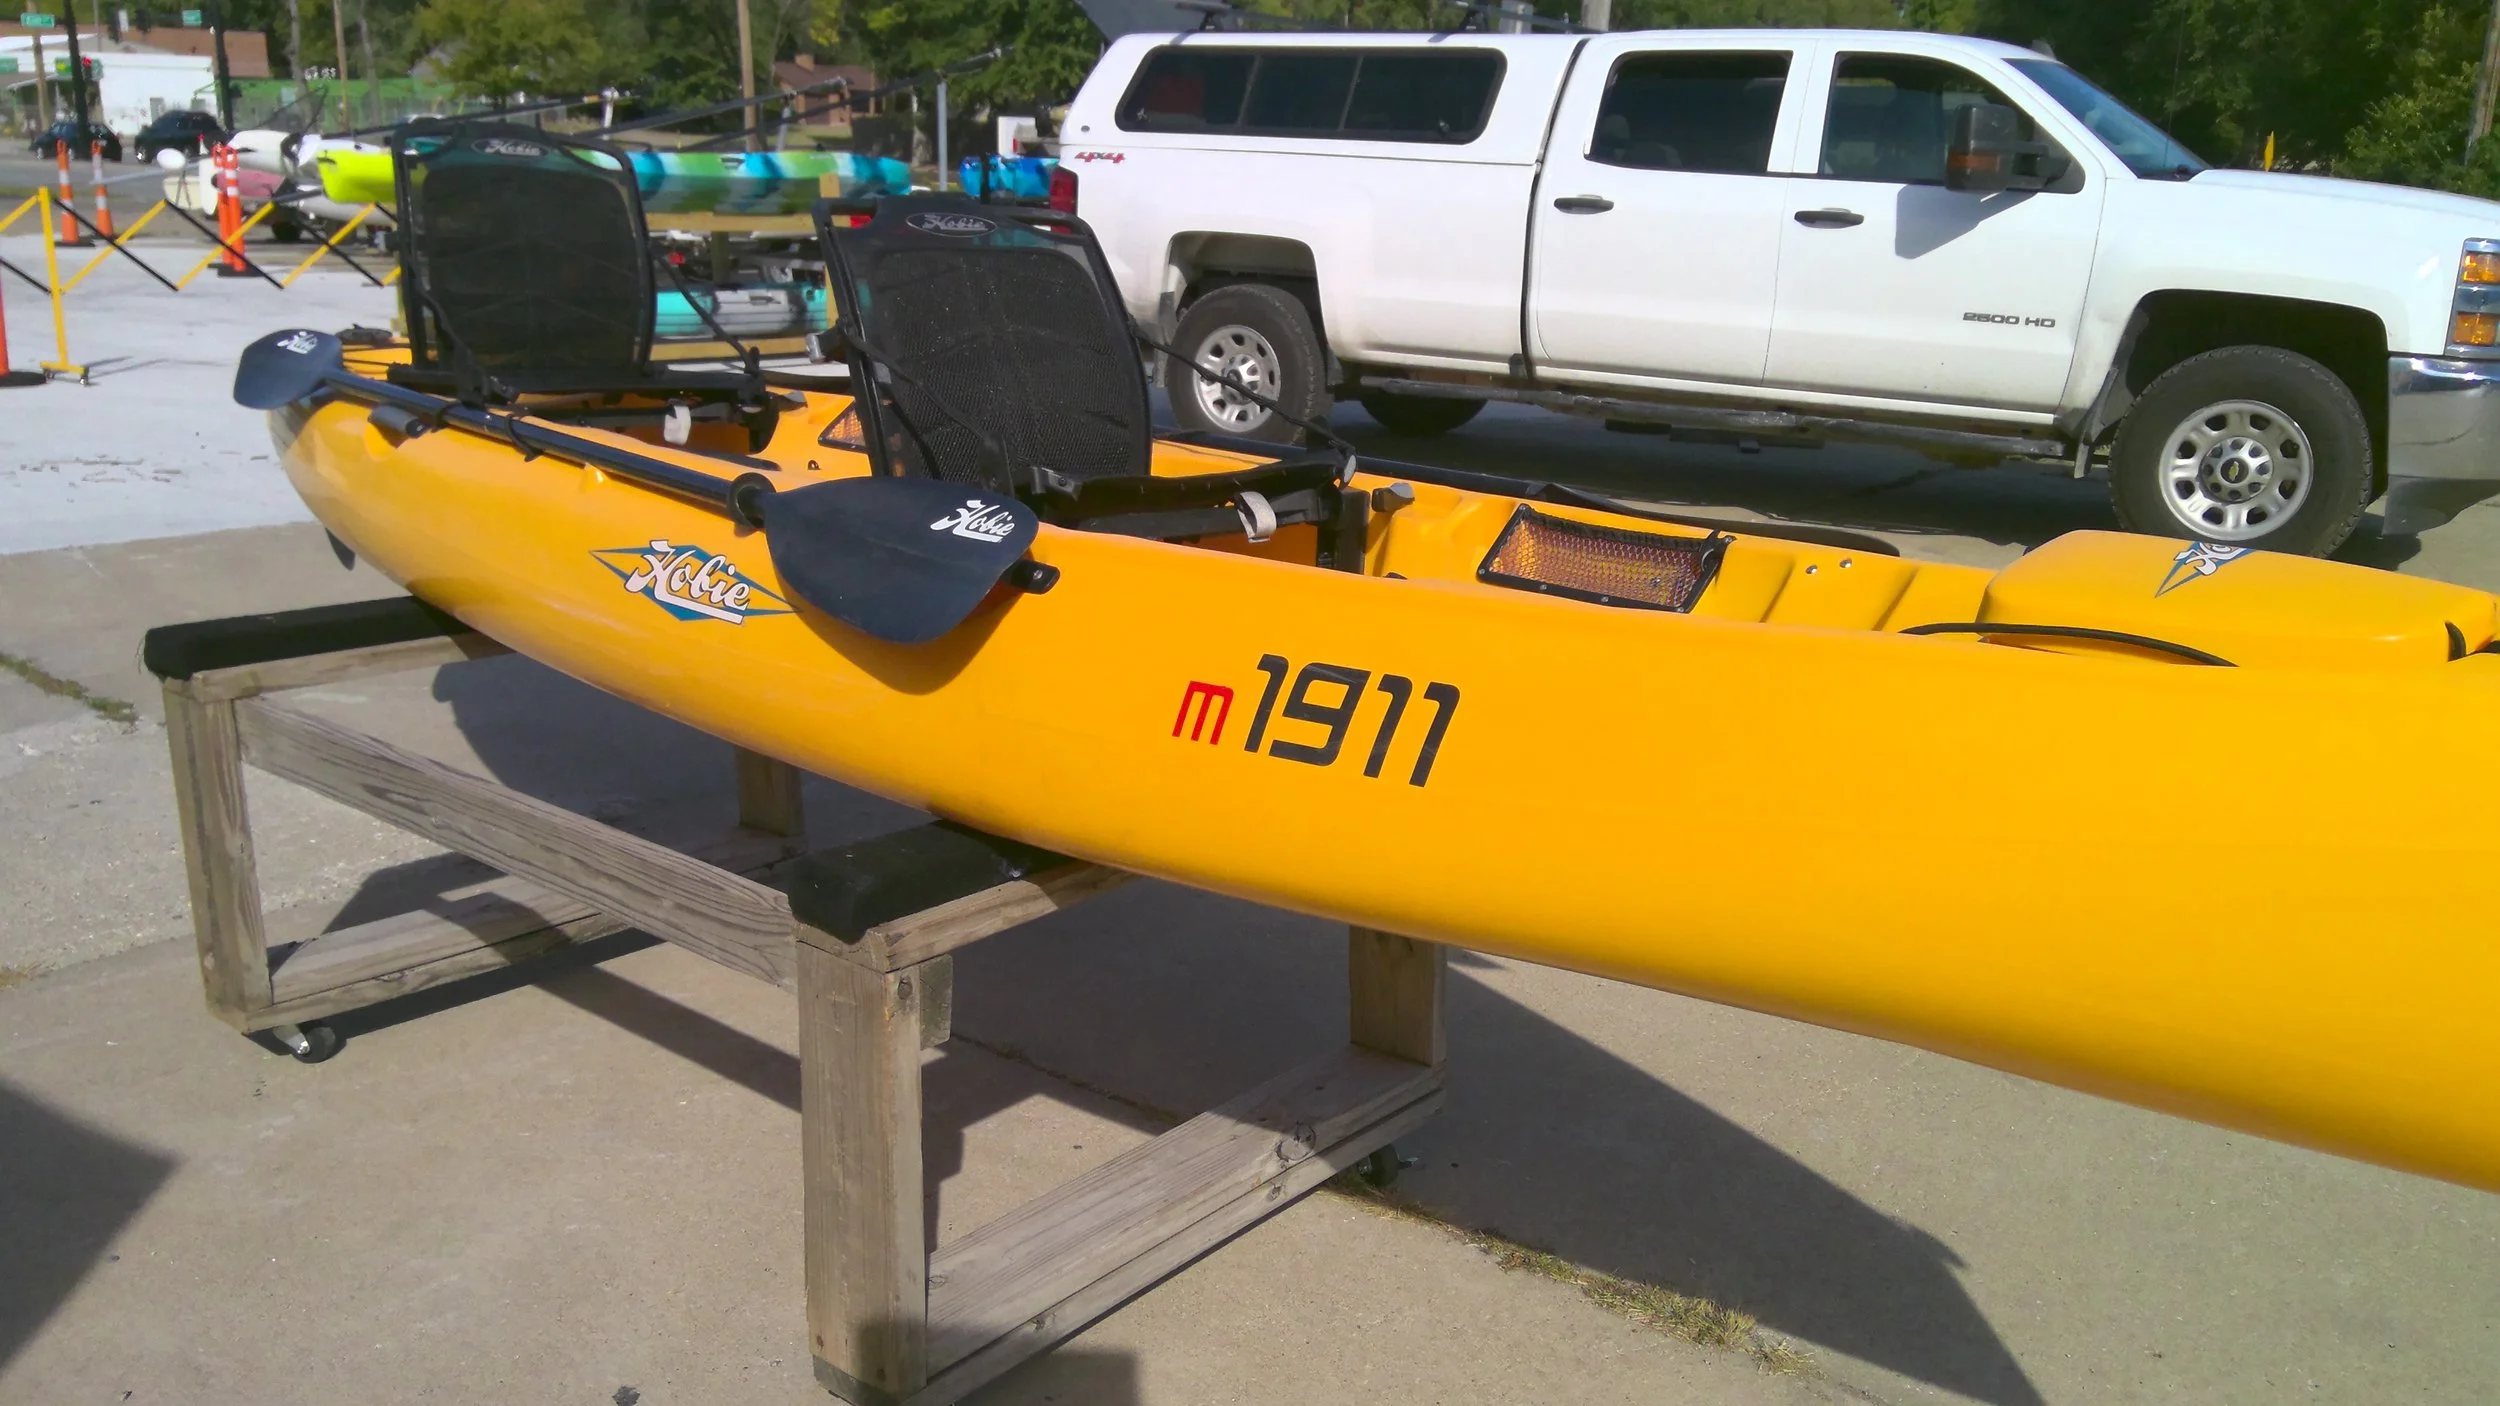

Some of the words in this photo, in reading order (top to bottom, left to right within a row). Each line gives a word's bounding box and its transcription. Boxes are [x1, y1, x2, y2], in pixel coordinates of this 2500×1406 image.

[921, 213, 988, 231] Hobie
[1963, 312, 2020, 325] 2500
[2025, 316, 2056, 328] HD
[930, 499, 1015, 543] Hobie
[624, 539, 751, 625] Hobie
